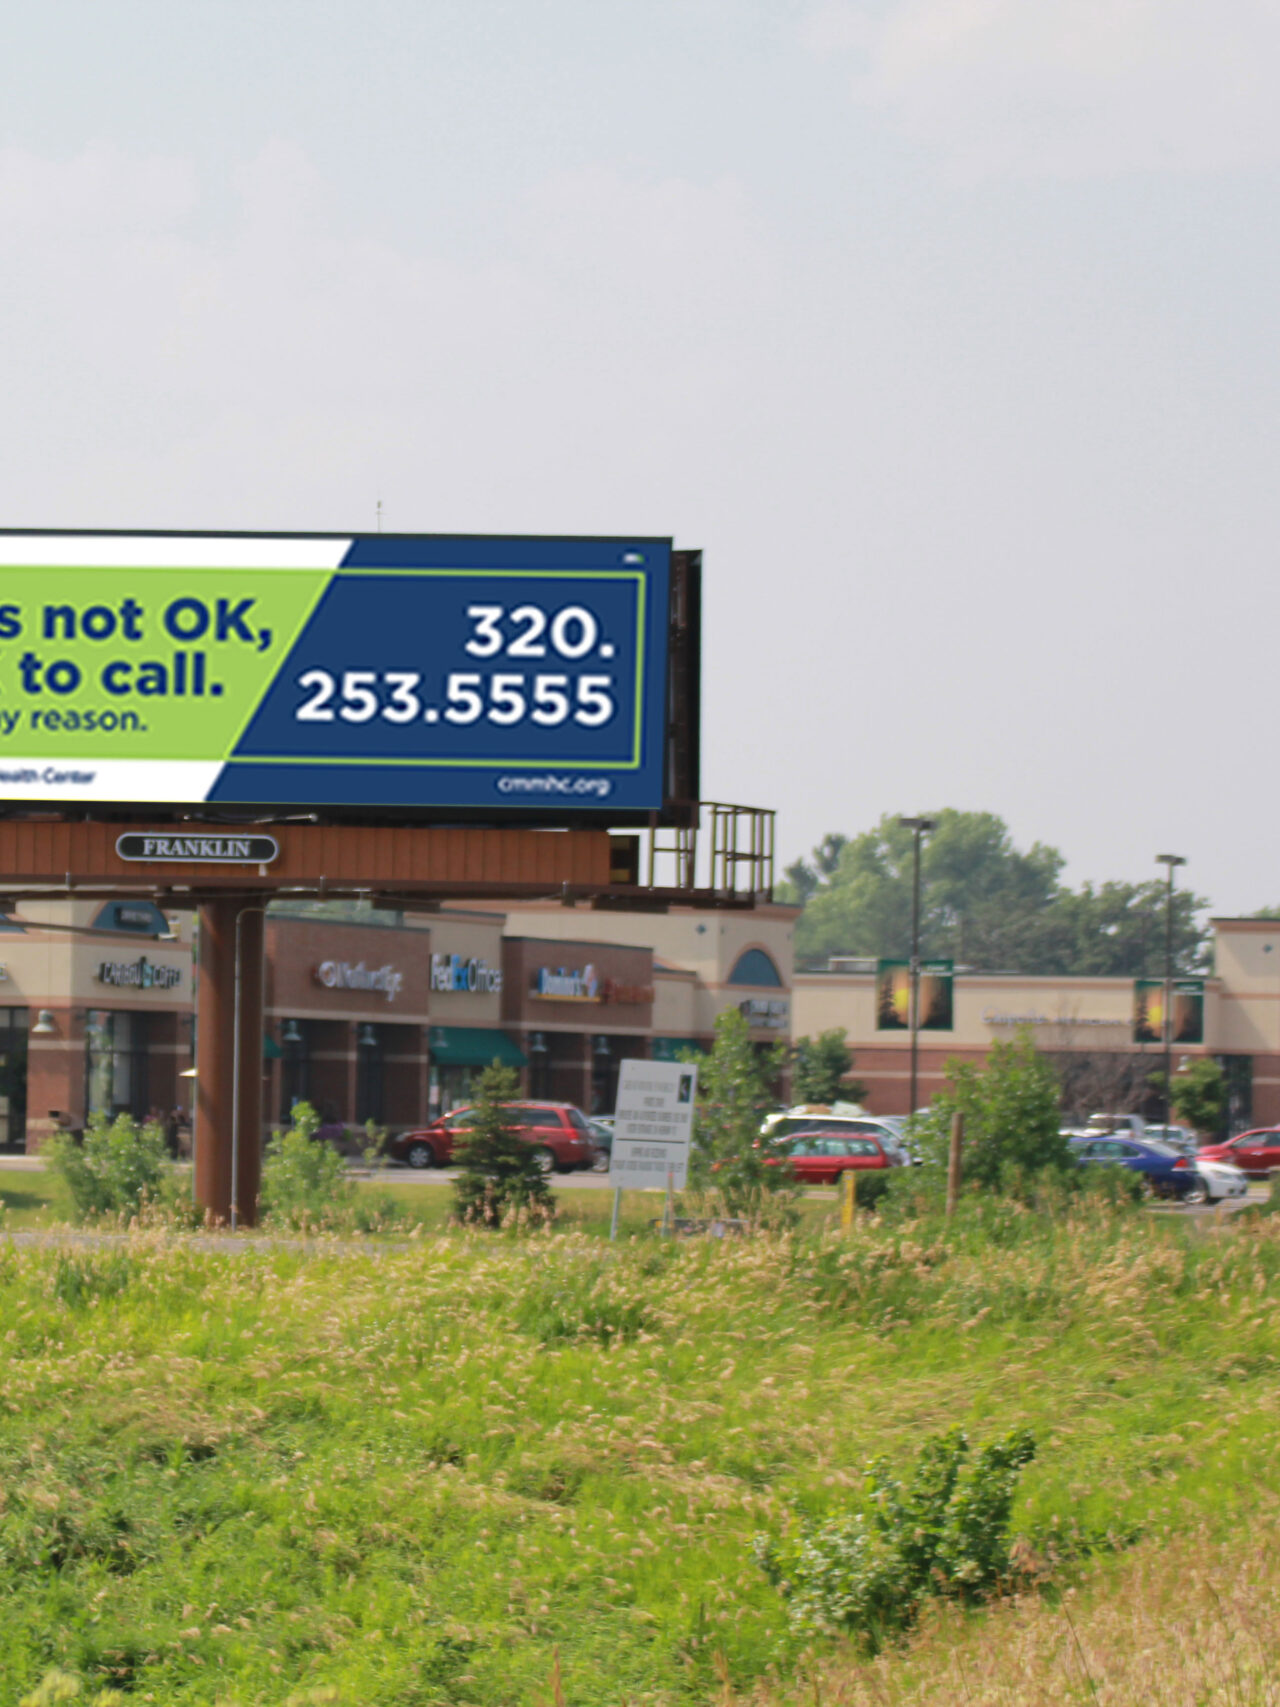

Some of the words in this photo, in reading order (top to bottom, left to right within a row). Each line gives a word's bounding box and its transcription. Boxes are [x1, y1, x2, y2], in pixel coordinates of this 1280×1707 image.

[42, 599, 144, 641] not
[164, 597, 273, 652] OK,
[465, 606, 615, 657] 320.
[19, 651, 81, 695] to
[101, 652, 224, 697] call.
[296, 670, 613, 725] 253.5555
[31, 707, 148, 732] reason.
[42, 766, 96, 784] Center
[498, 774, 610, 797] cmmhc.org
[143, 839, 251, 857] FRANKLIN
